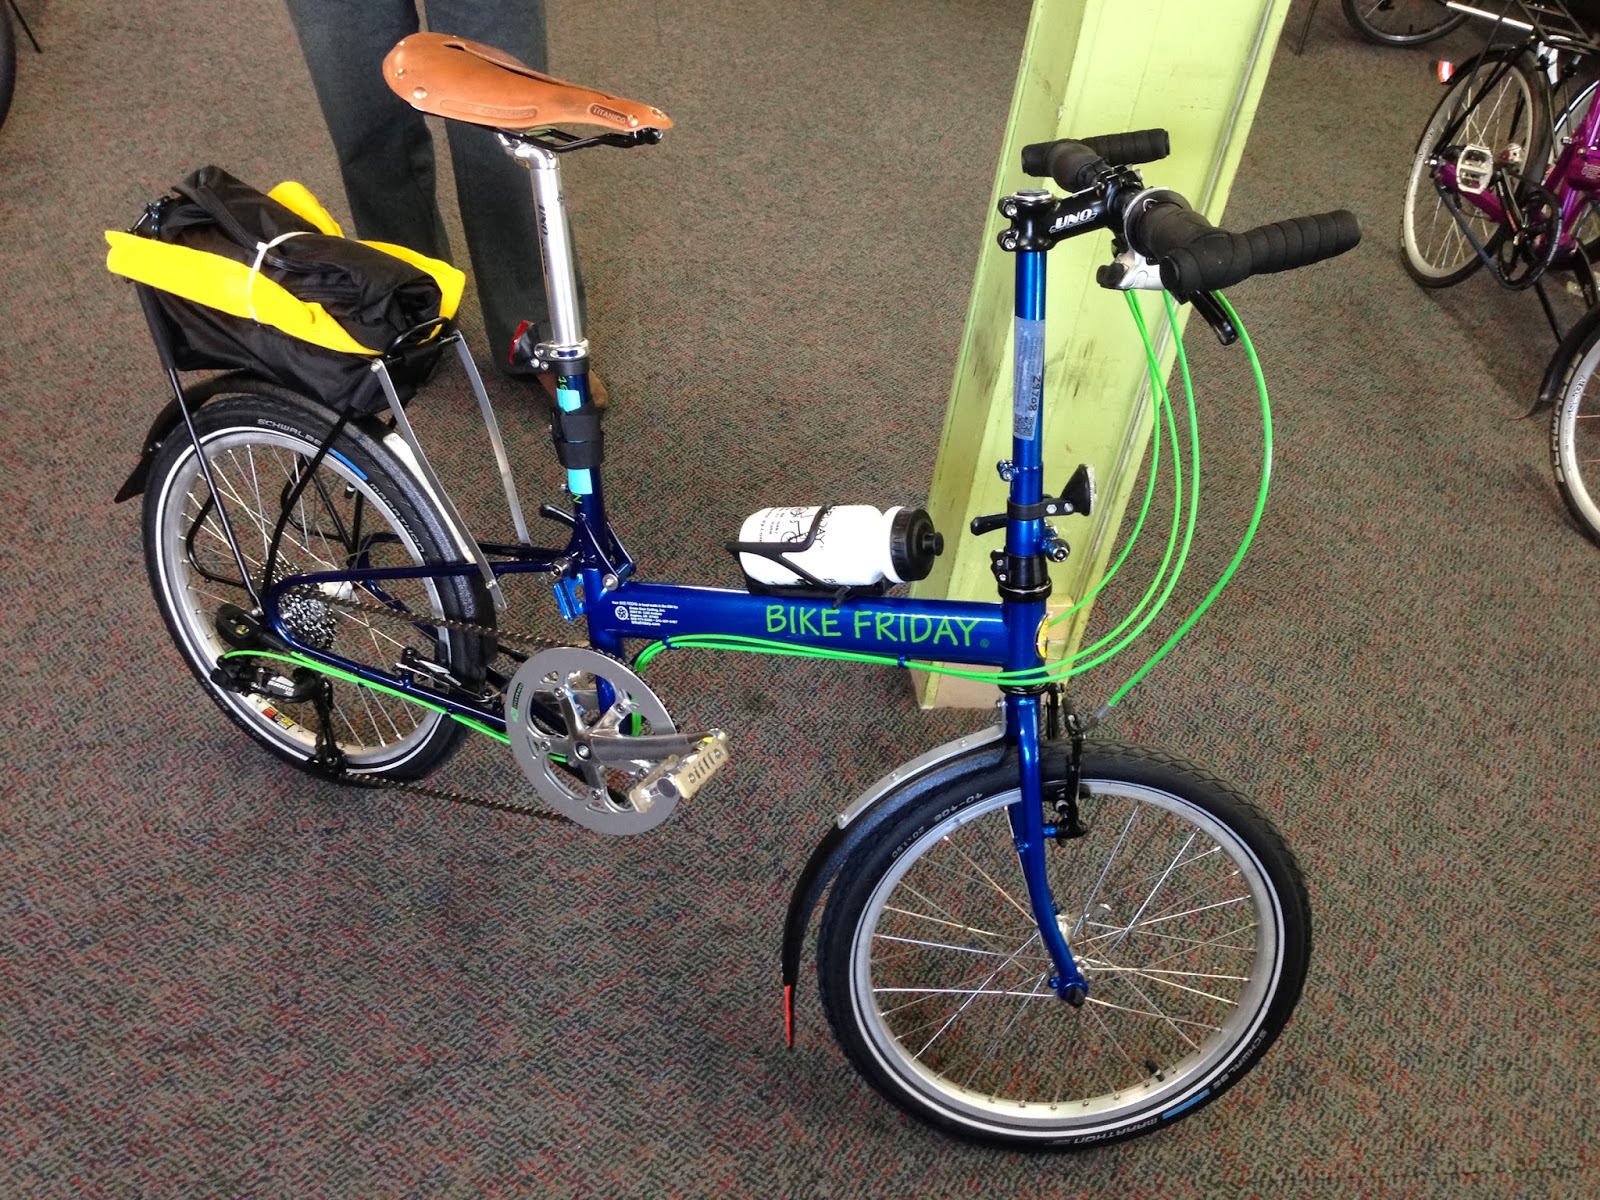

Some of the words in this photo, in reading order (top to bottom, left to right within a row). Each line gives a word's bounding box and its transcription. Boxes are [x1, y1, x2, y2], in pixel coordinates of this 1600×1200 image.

[592, 105, 626, 124] TITANICO
[1055, 208, 1093, 229] UNO
[257, 418, 323, 446] SCHWALBE
[370, 483, 425, 553] MARATHON
[766, 604, 842, 637] BIKE
[854, 610, 981, 647] FRIDAY
[933, 792, 983, 822] 40-406
[1213, 1028, 1267, 1090] SCHWALBE
[1074, 1117, 1158, 1145] MARATHON
